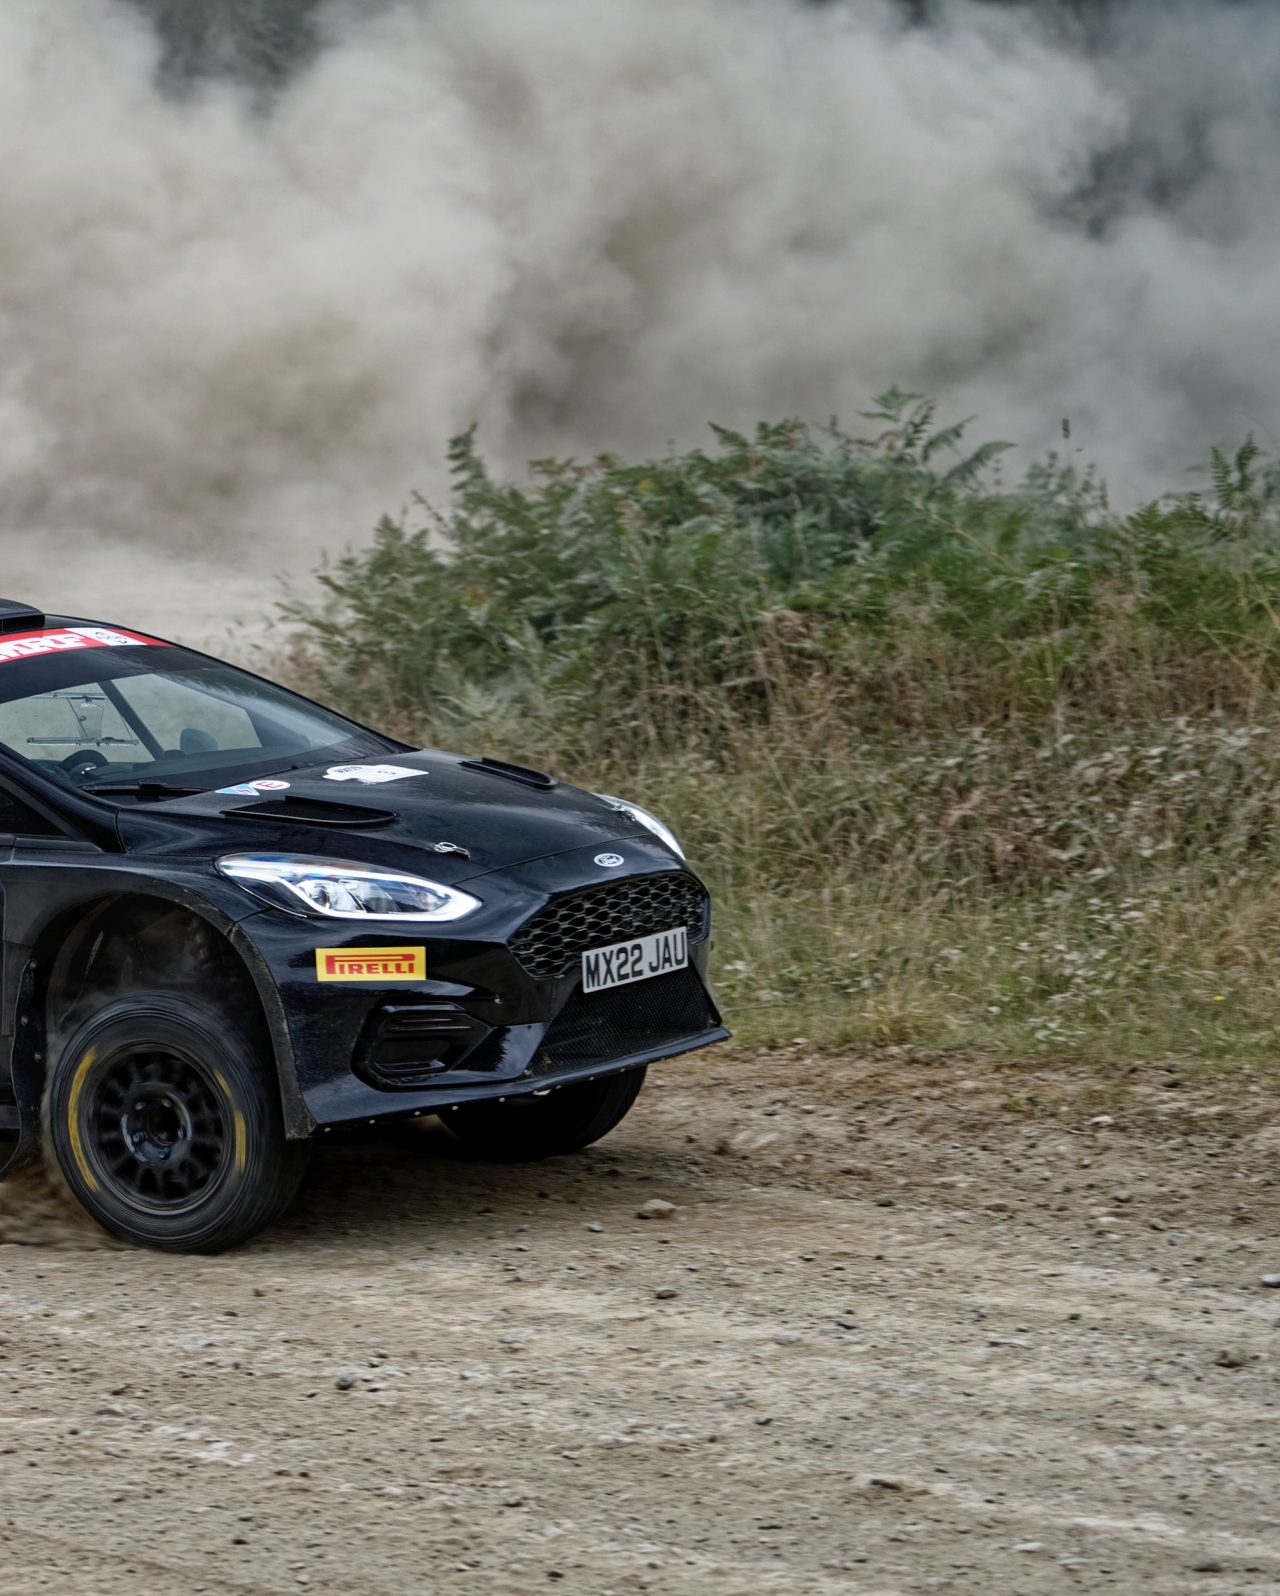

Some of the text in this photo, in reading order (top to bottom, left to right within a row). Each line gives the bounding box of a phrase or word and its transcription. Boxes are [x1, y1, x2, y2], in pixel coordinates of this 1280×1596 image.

[325, 952, 416, 976] PIRELLI
[586, 929, 688, 989] MX22 JAU
